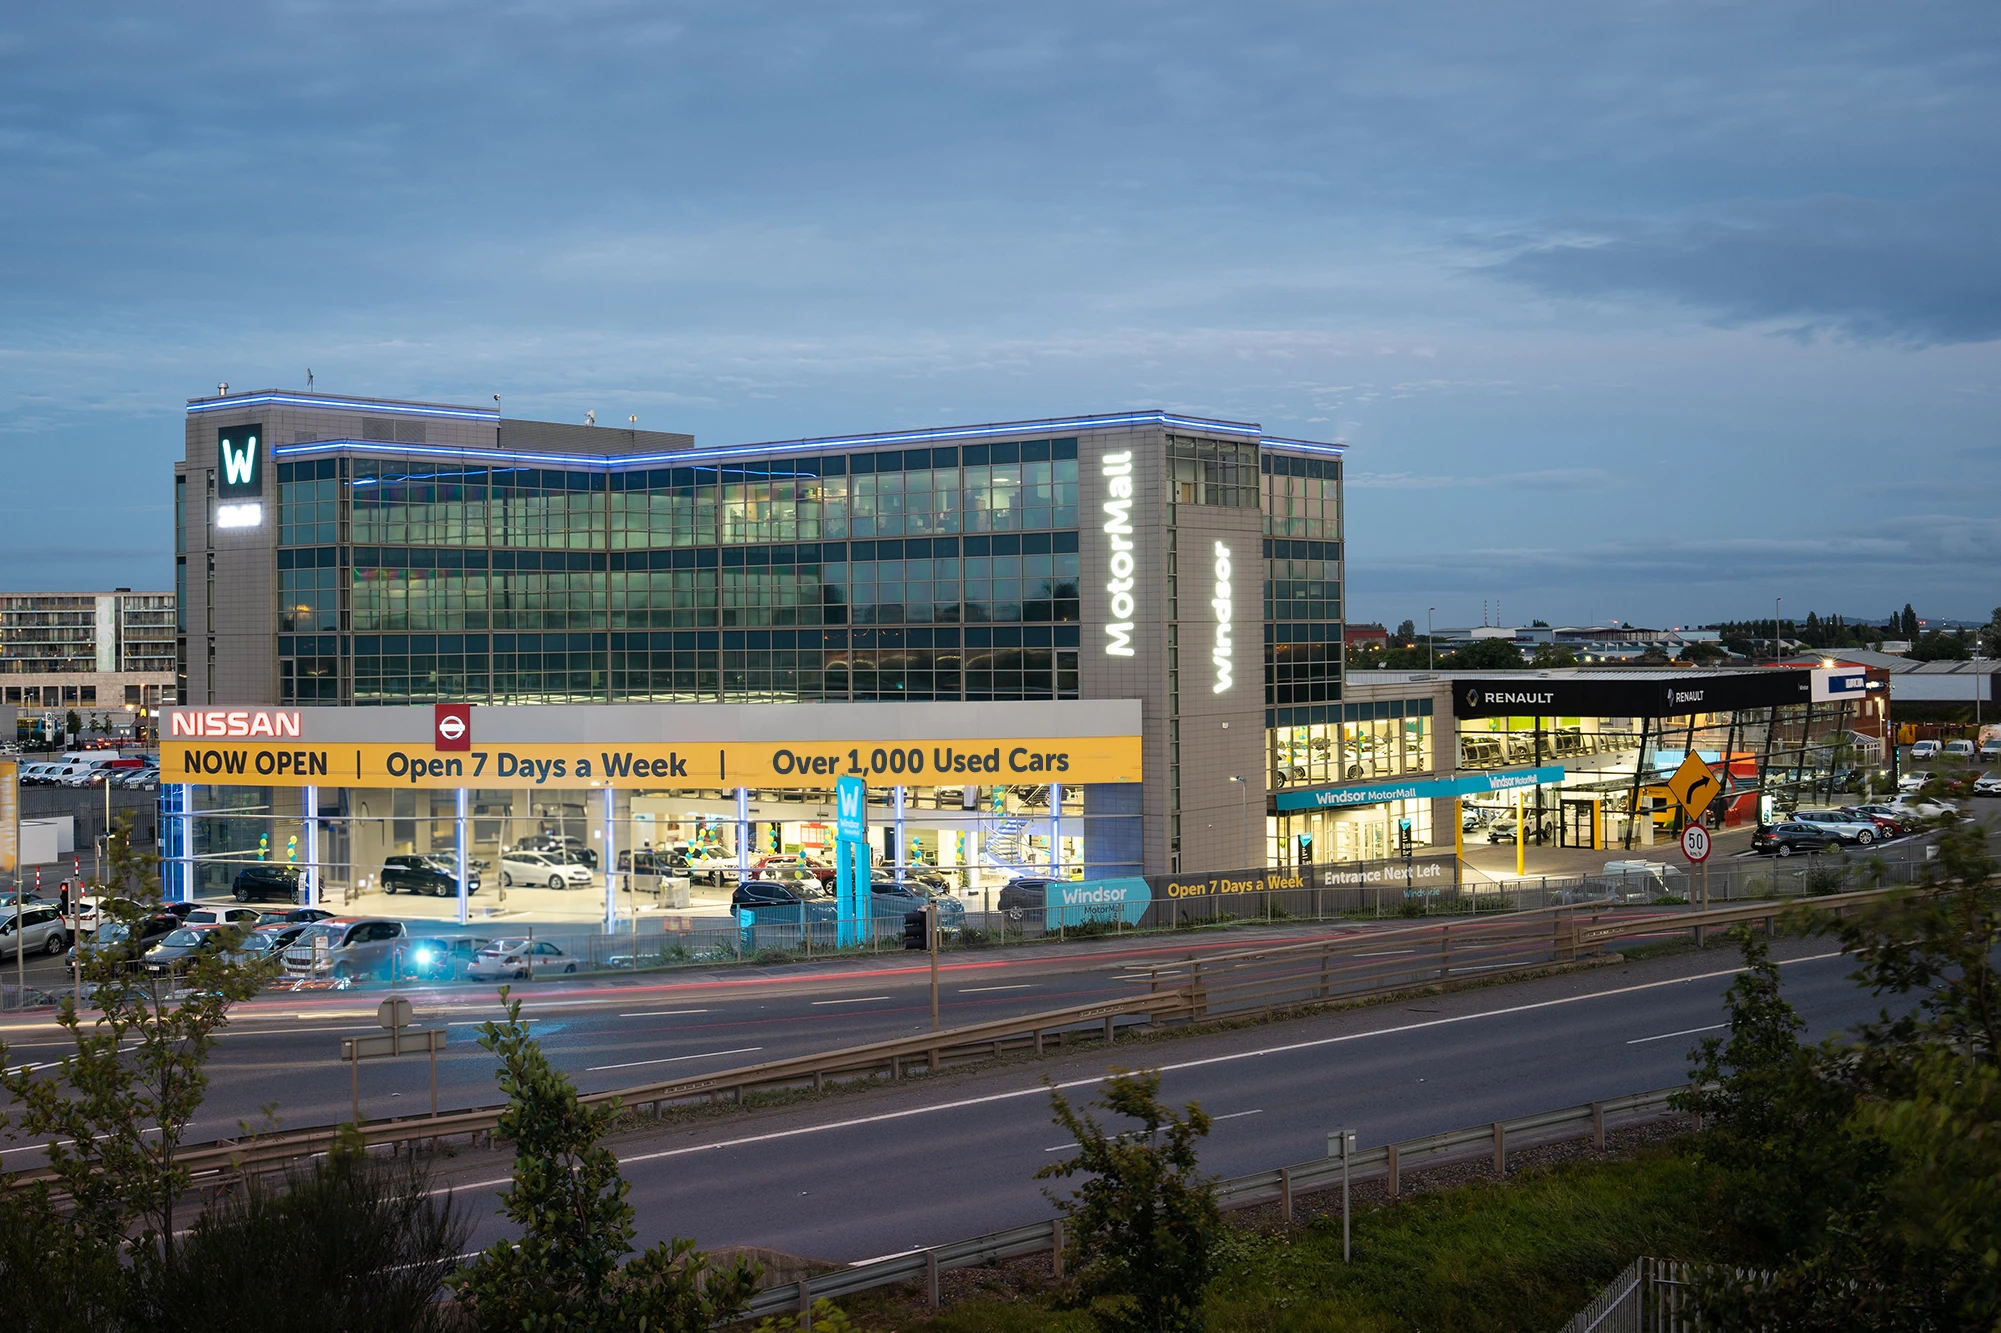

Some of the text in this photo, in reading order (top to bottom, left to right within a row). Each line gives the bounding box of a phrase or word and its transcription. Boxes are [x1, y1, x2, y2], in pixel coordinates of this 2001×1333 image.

[222, 436, 256, 485] W
[1102, 450, 1135, 657] MotorMall
[1211, 540, 1233, 695] Windsor
[1484, 692, 1554, 703] RENAULT
[1676, 690, 1704, 703] RENAULT
[172, 712, 301, 737] NISSAN
[184, 750, 328, 776] NOW OPEN
[386, 752, 688, 784] Open 7 Days a Week
[772, 747, 1070, 777] Over 1,000 Used Cars
[1488, 773, 1538, 789] Windsor MotorMall
[839, 784, 860, 817] W
[1315, 787, 1417, 805] Windsor MotorMall
[1688, 833, 1704, 850] 50
[1167, 875, 1304, 899] Open 7 Days a Week
[1324, 864, 1441, 886] Entrance Next Left
[1062, 886, 1128, 904] Windsor
